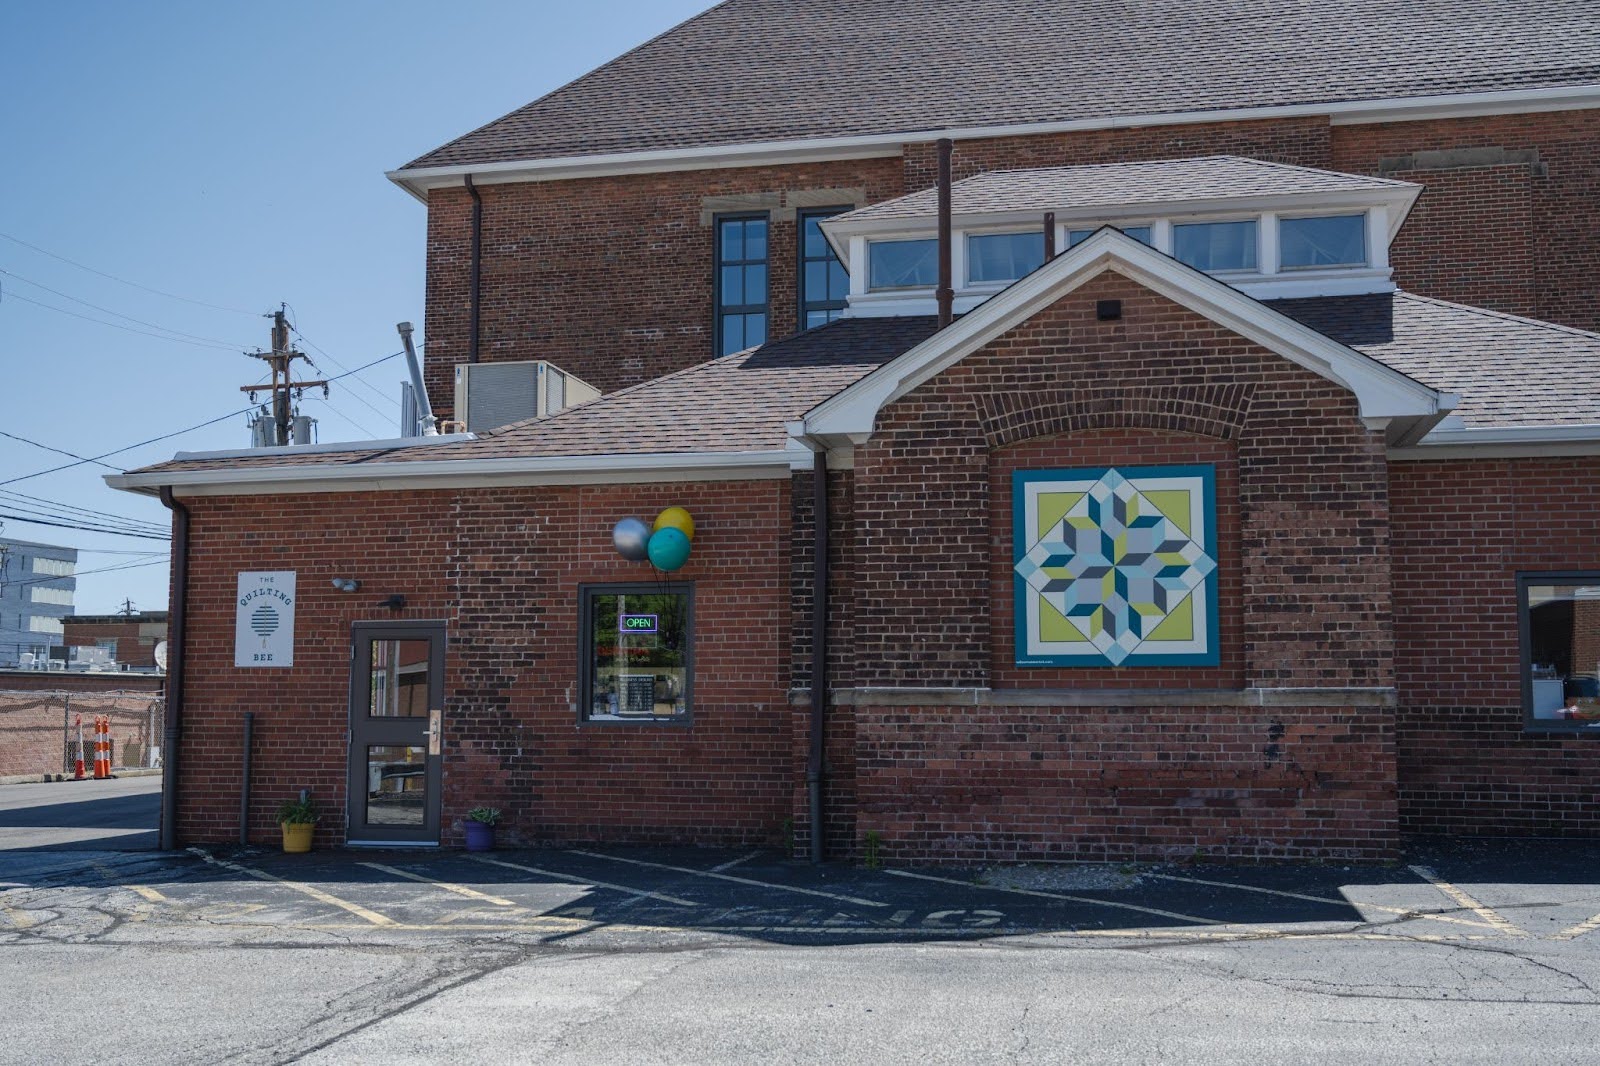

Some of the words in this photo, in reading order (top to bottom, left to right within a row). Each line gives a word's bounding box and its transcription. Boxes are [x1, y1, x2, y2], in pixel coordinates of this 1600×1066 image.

[240, 588, 292, 607] QUILTING
[626, 618, 651, 628] OPEN
[253, 653, 273, 661] BEE
